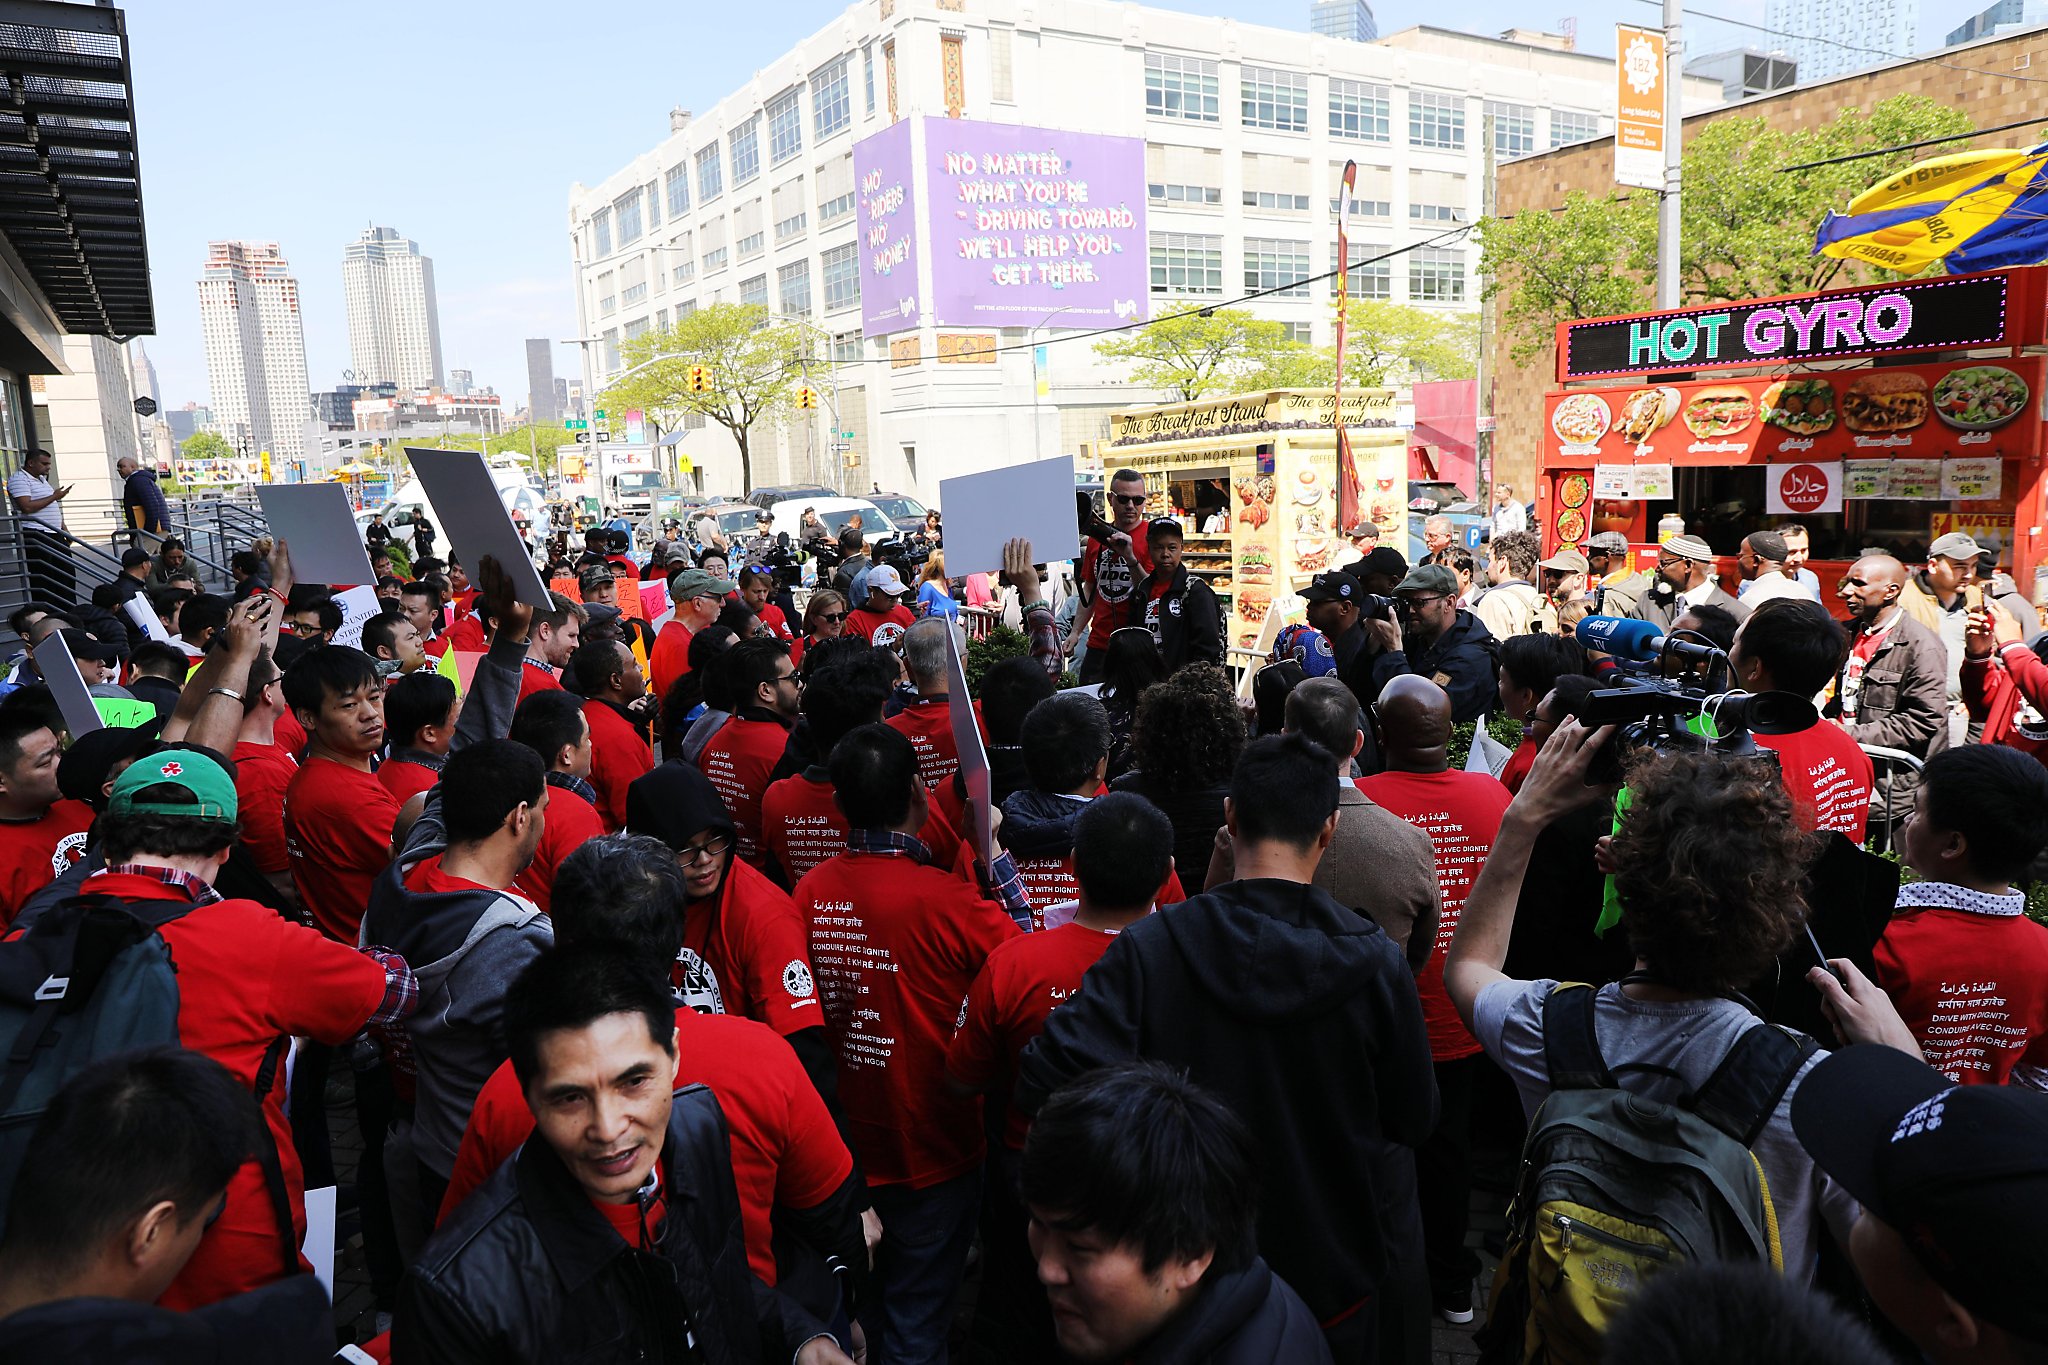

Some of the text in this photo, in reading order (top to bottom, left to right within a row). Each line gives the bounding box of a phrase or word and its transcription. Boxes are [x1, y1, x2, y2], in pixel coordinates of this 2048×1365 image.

[1633, 56, 1650, 73] IBZ
[1621, 106, 1661, 120] Long Island City
[945, 150, 1062, 176] NO MATTER
[959, 179, 1089, 203] WHAT YOU'RE
[870, 186, 904, 220] RIDERS
[976, 207, 1137, 231] DRIVING TOWARD,
[959, 233, 1112, 259] WE'LL HELP YOU
[875, 235, 911, 274] MONEY
[993, 259, 1099, 286] GET THERE.
[1113, 299, 1137, 318] lyft
[1628, 292, 1913, 366] HOT GYRO
[1287, 394, 1392, 411] The Beakfast
[1120, 398, 1268, 435] The Breakfast Stand
[612, 454, 641, 464] FedEx
[1131, 449, 1241, 468] COFFEE AND MORE!
[1956, 464, 1986, 473] Shrimp
[1783, 473, 1826, 496] حلال
[1973, 474, 1991, 482] Rice
[1470, 529, 1479, 546] P
[349, 608, 378, 624] UNITED
[1588, 620, 1609, 630] AFP
[1429, 812, 1450, 823] القيادة
[1462, 845, 1489, 853] DIGNITÉ
[1451, 856, 1475, 864] KHORÉ
[813, 900, 854, 913] القيادة بكرامة
[846, 932, 868, 941] DIGNITY
[812, 944, 844, 952] CONDUIRE
[845, 945, 861, 953] AVEC
[875, 961, 899, 972] JIKKÉ
[1940, 982, 1997, 995] القيادة بكرامة
[1932, 1012, 2010, 1022] DRIVE WITH DIGNITY
[1927, 1023, 2028, 1036] CONDUIRE AVEC DIGNITÉ
[1973, 1036, 2007, 1048] KHORÉ
